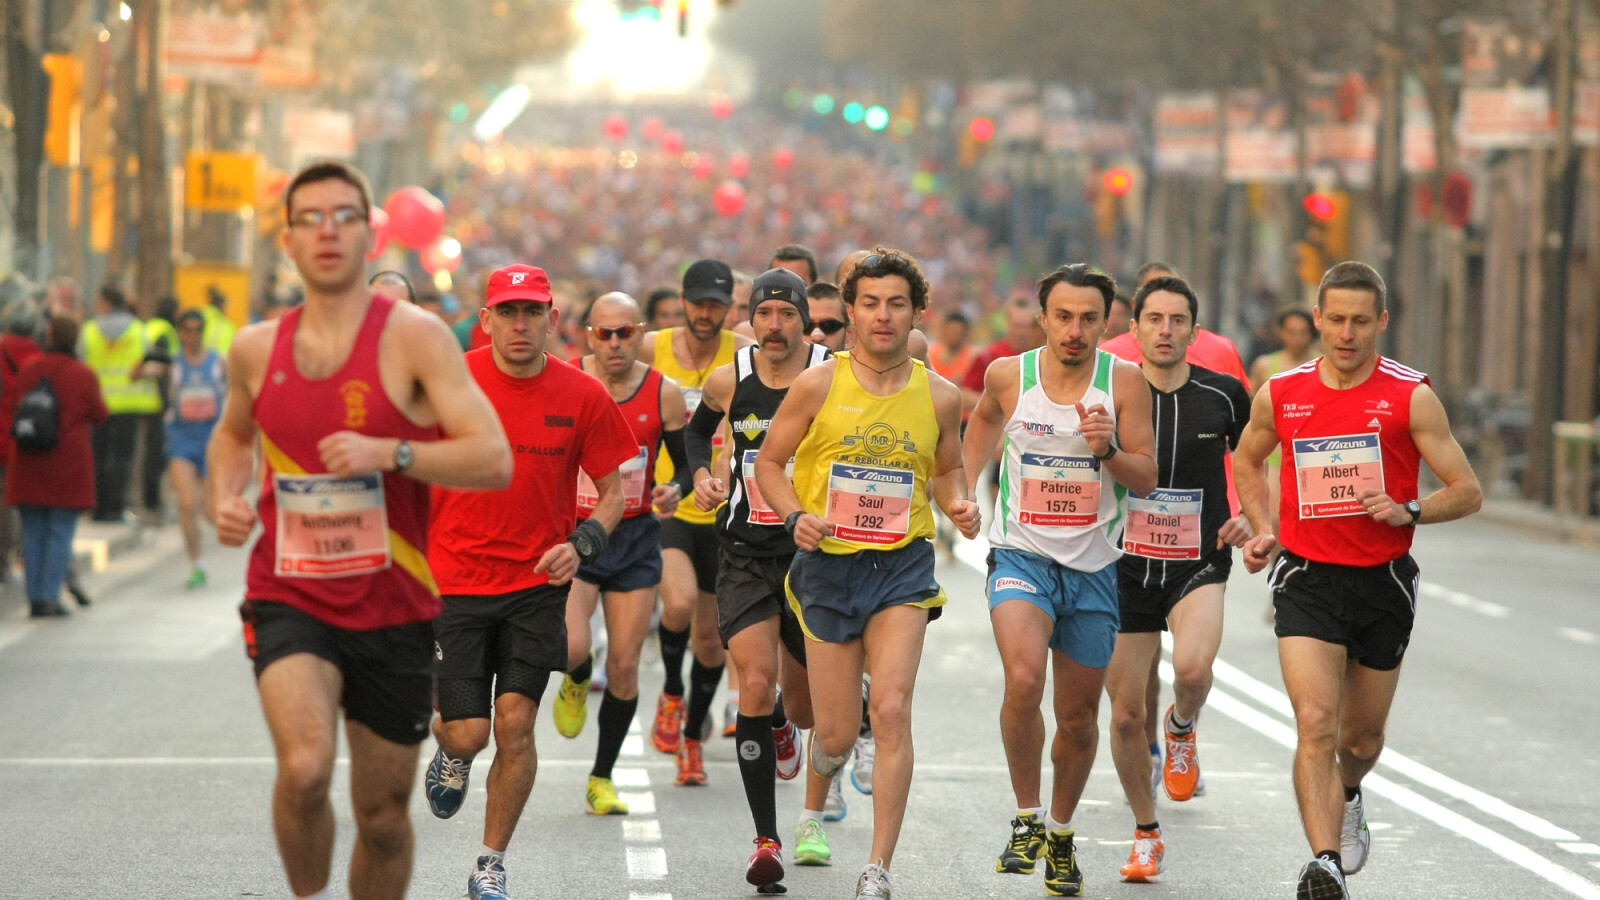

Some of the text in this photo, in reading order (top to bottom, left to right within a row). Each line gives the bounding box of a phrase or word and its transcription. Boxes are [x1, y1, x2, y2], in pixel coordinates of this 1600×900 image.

[870, 435, 889, 446] JMR
[903, 431, 910, 440] R
[855, 456, 902, 468] REBOLLAR
[1322, 465, 1360, 479] Albert
[1040, 481, 1082, 495] Patrice
[1330, 485, 1356, 499] 874
[858, 495, 884, 509] Saul
[1046, 500, 1077, 513] 1575
[854, 514, 884, 529] 1292
[1147, 513, 1181, 528] Daniel
[1149, 531, 1178, 545] 1172
